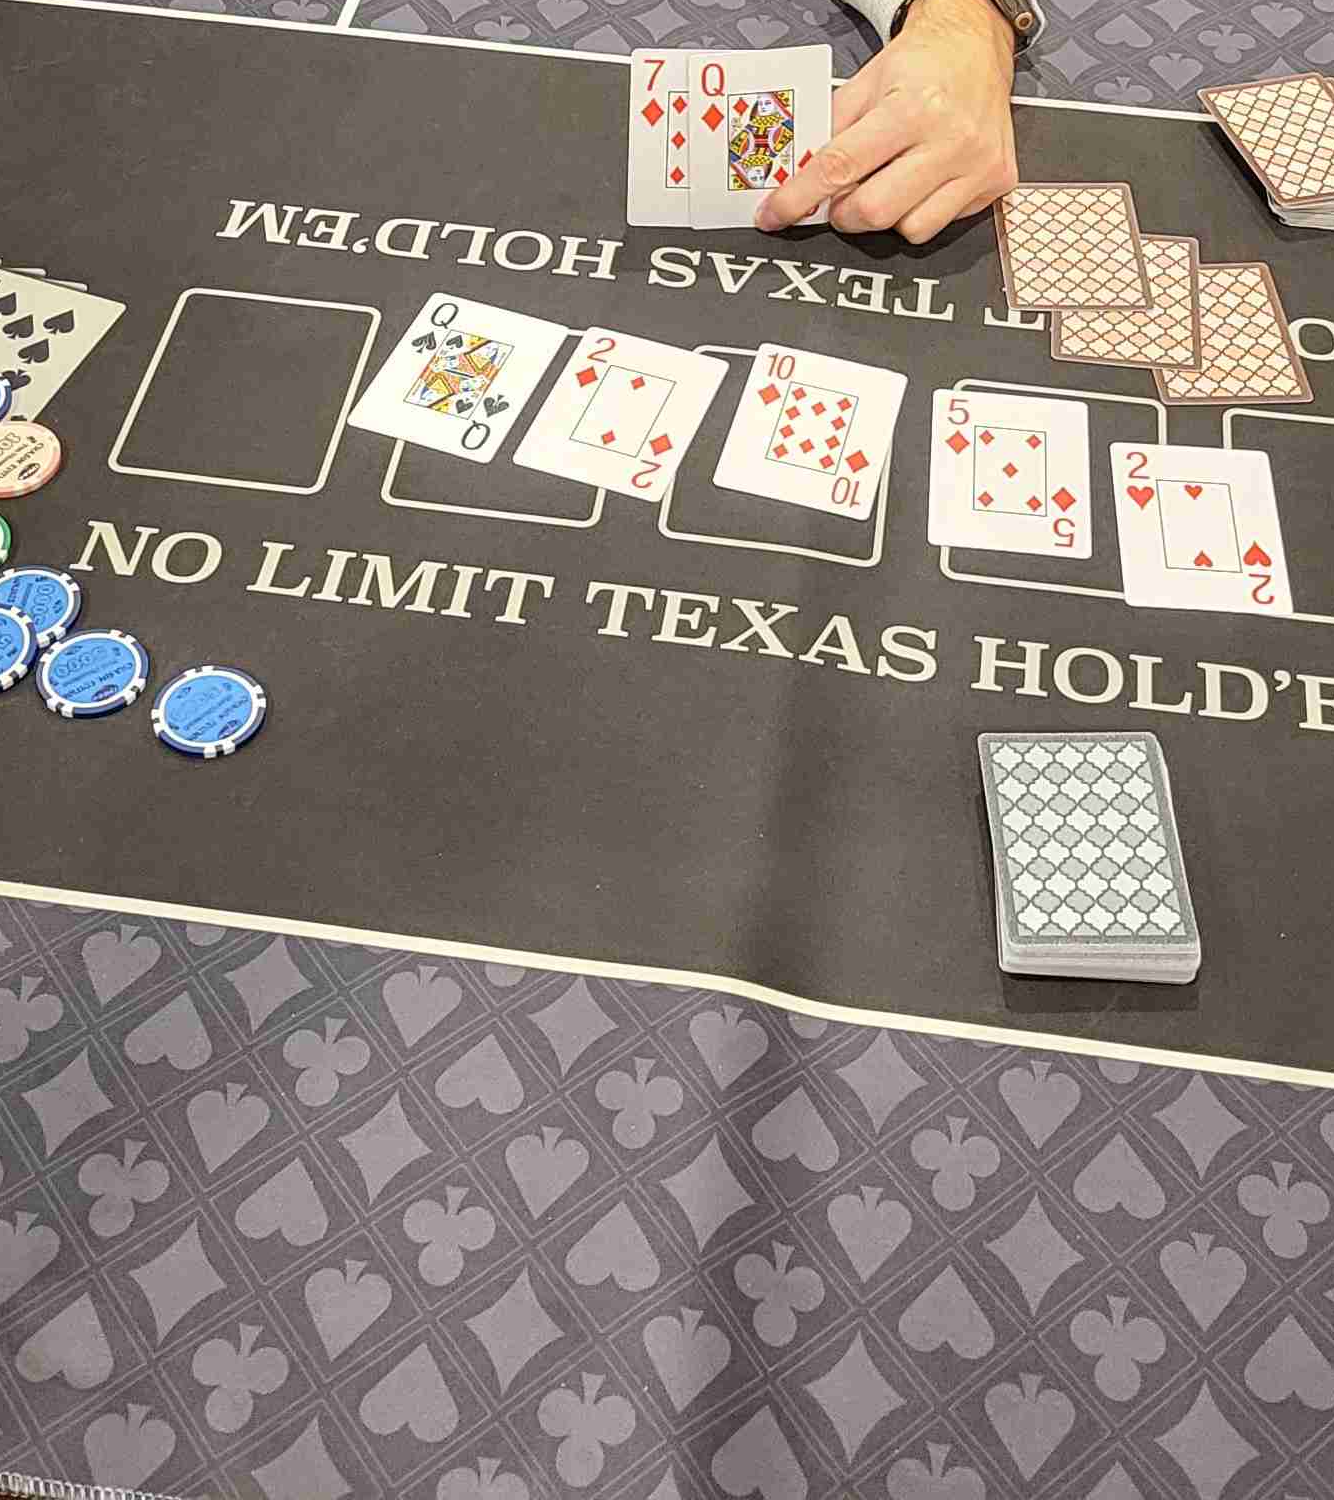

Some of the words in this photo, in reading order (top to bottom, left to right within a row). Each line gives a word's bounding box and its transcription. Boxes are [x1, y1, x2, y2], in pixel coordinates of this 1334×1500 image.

[643, 59, 666, 91] 7
[701, 63, 725, 97] Q
[215, 199, 624, 281] HOLD'EM
[647, 246, 955, 322] TEXAS
[430, 302, 459, 329] Q
[587, 337, 616, 363] 2
[766, 352, 796, 380] 10
[947, 398, 969, 425] 5
[461, 419, 491, 450] Q
[631, 459, 662, 488] 2
[1126, 451, 1150, 480] 2
[830, 476, 861, 509] 10
[1052, 518, 1075, 548] 5
[69, 520, 223, 585] NO
[245, 540, 555, 625] LIMIT
[585, 580, 938, 683] TEXAS
[1248, 573, 1275, 605] 2
